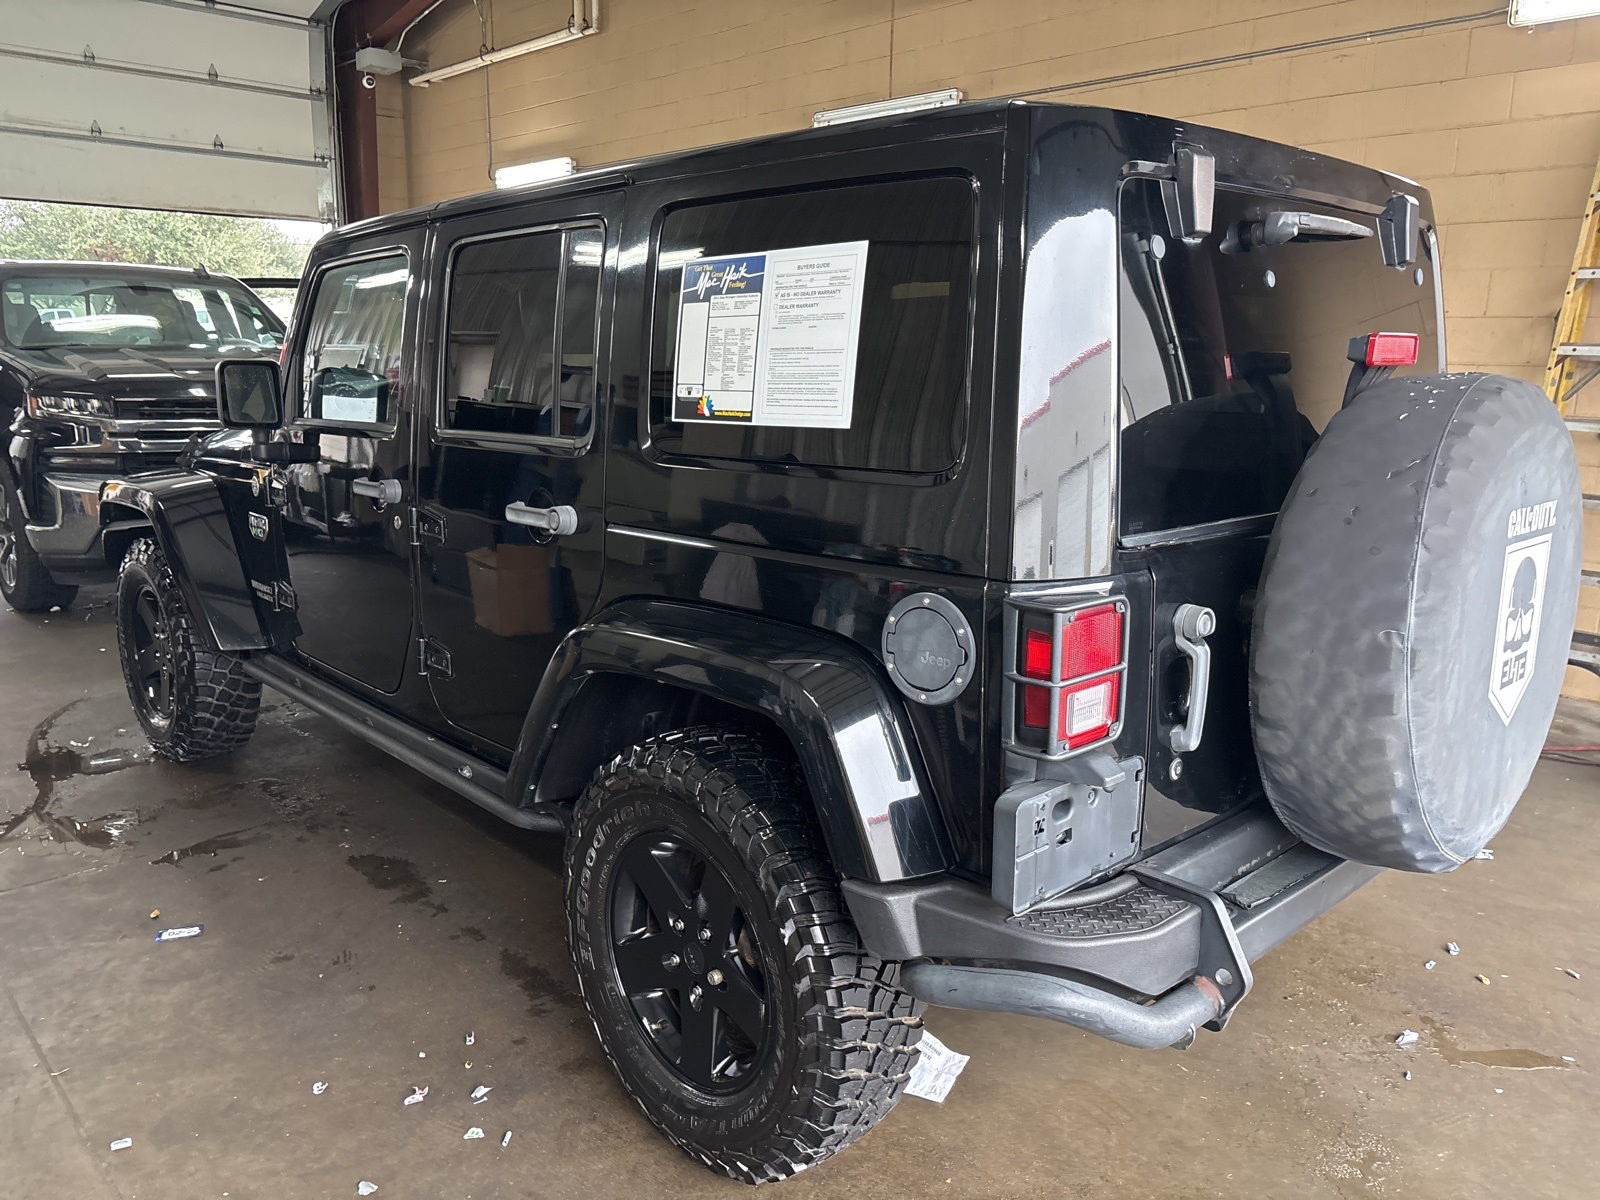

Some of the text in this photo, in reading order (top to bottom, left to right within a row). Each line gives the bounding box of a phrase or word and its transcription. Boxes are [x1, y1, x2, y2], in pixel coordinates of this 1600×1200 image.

[720, 262, 750, 294] Haik
[1508, 506, 1531, 539] CALL
[920, 651, 952, 669] Jeep
